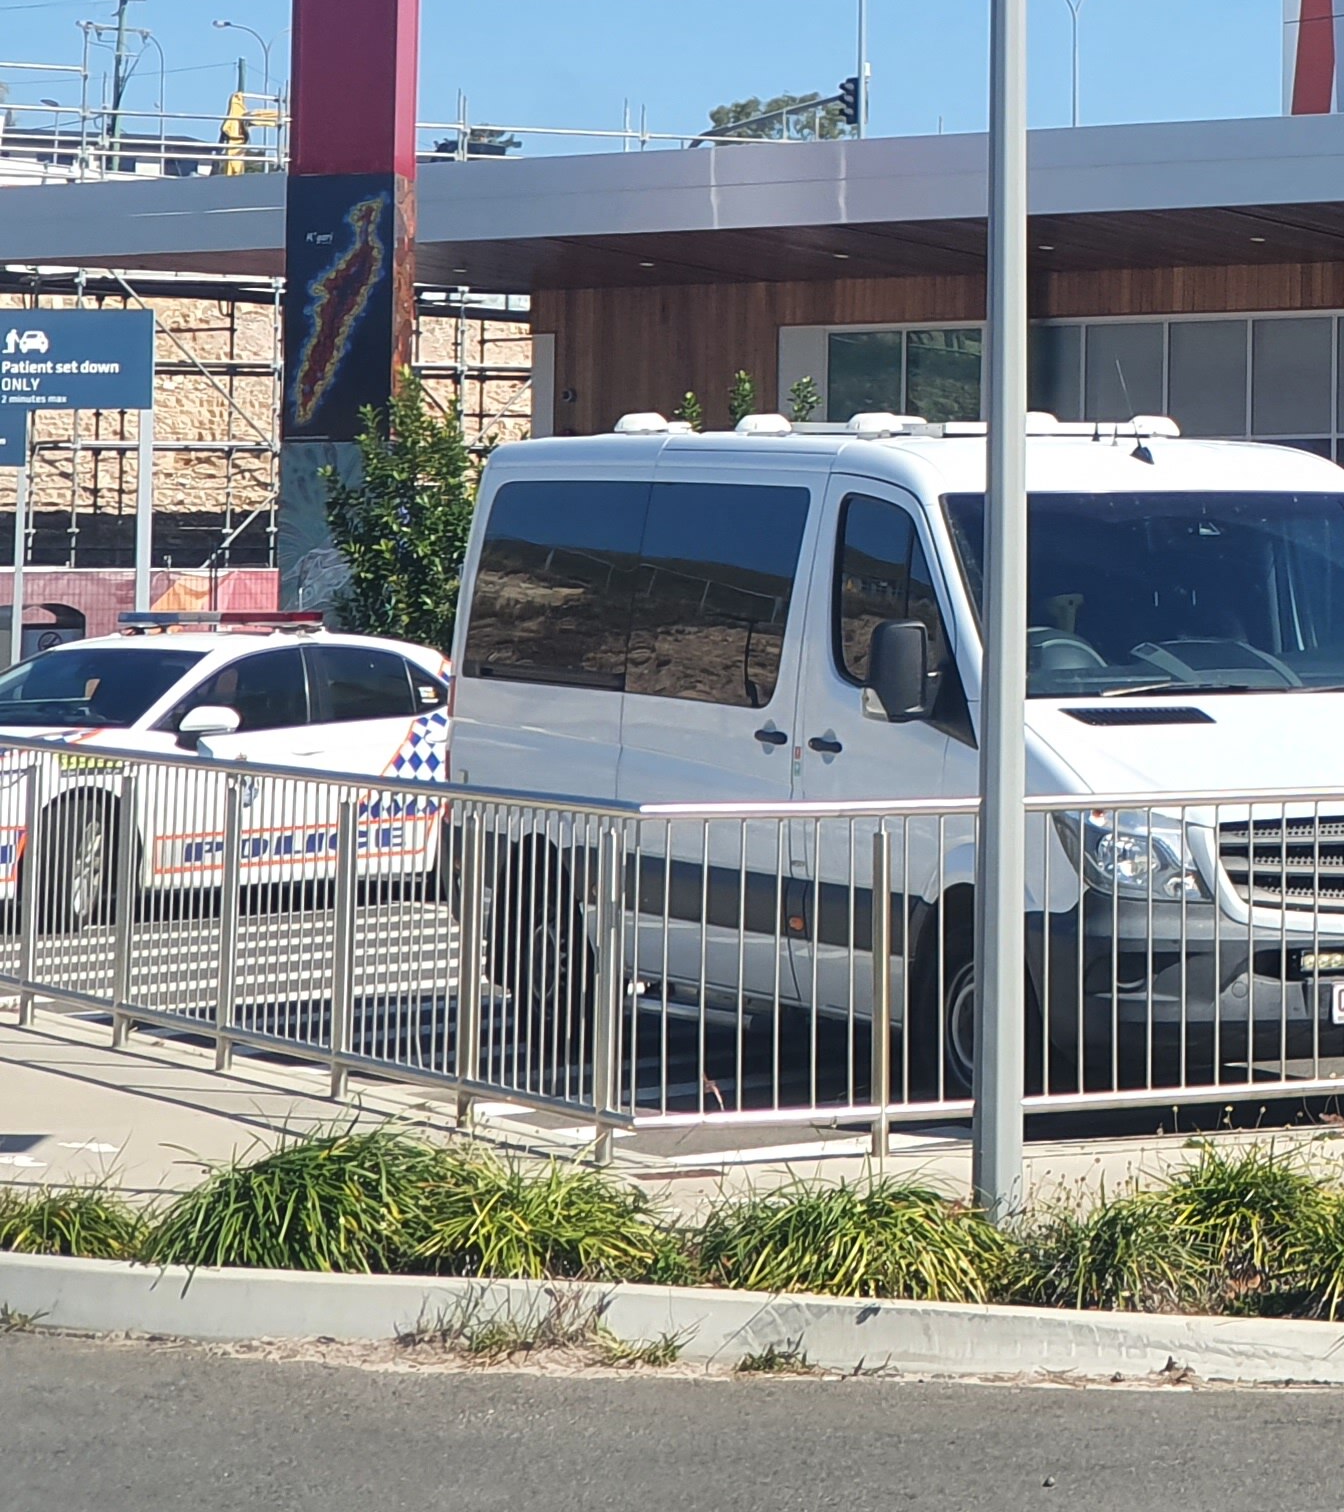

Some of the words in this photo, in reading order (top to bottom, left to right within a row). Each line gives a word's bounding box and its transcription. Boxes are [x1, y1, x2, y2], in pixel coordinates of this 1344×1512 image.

[1, 360, 53, 374] Patient
[55, 361, 79, 374] set
[80, 360, 120, 374] down
[1, 377, 40, 391] ONLY
[1, 394, 7, 404] 2
[8, 394, 47, 404] minutes
[47, 395, 68, 404] max
